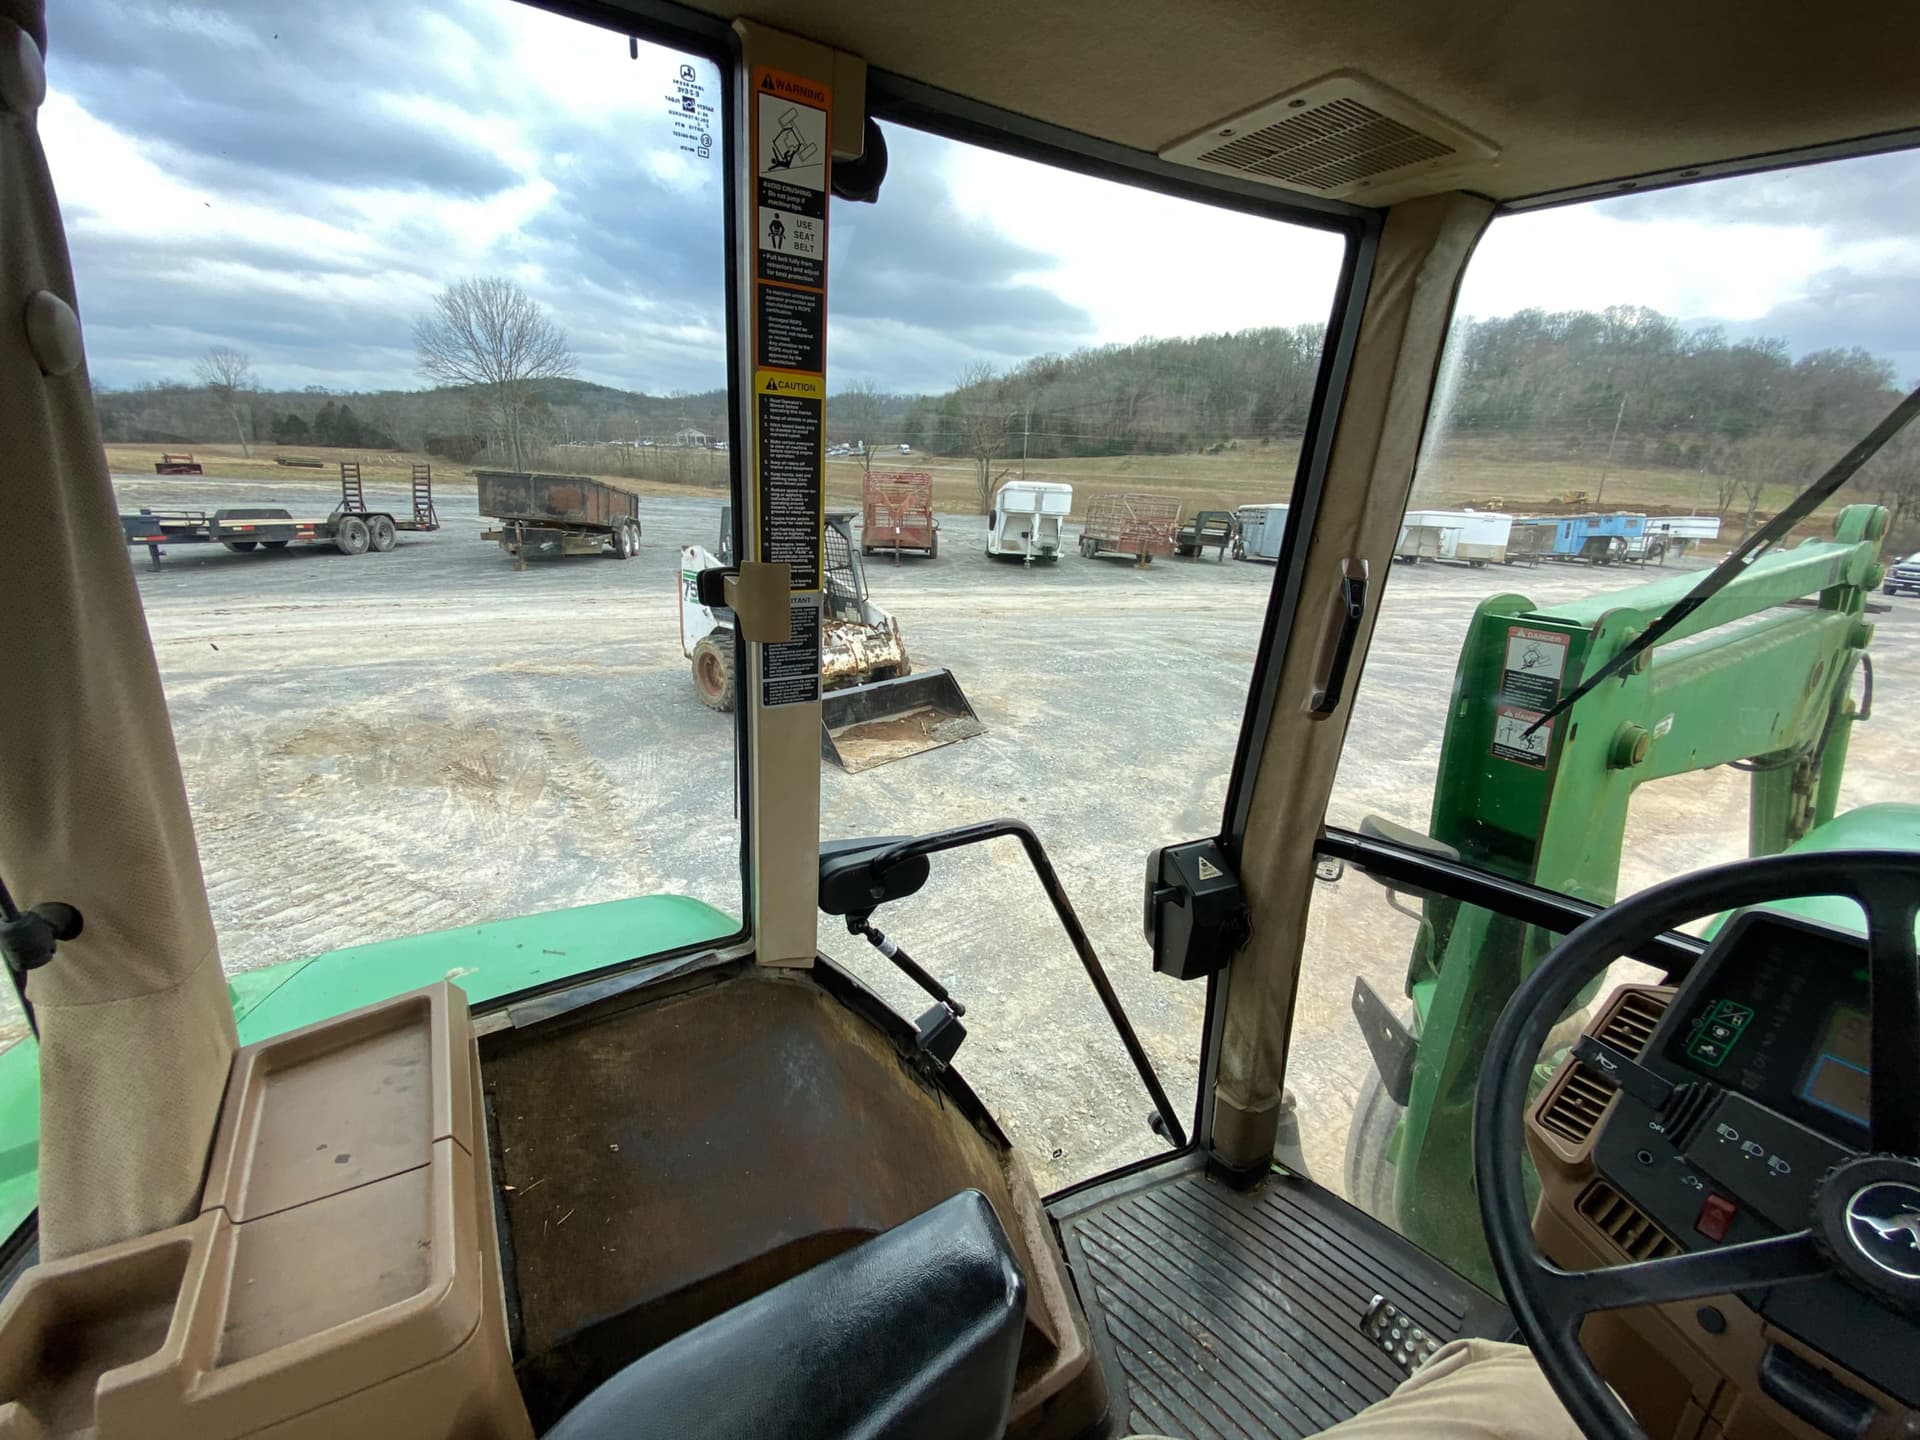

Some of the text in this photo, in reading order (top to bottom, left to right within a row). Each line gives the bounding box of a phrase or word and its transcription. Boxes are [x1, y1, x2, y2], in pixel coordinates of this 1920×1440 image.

[775, 79, 825, 102] WARNING
[763, 181, 781, 190] AVOID
[787, 195, 800, 203] jump
[797, 219, 813, 230] USE
[794, 230, 815, 241] SEAT
[794, 242, 815, 253] BELT
[778, 380, 816, 392] CAUTION
[1527, 632, 1563, 643] DANGER
